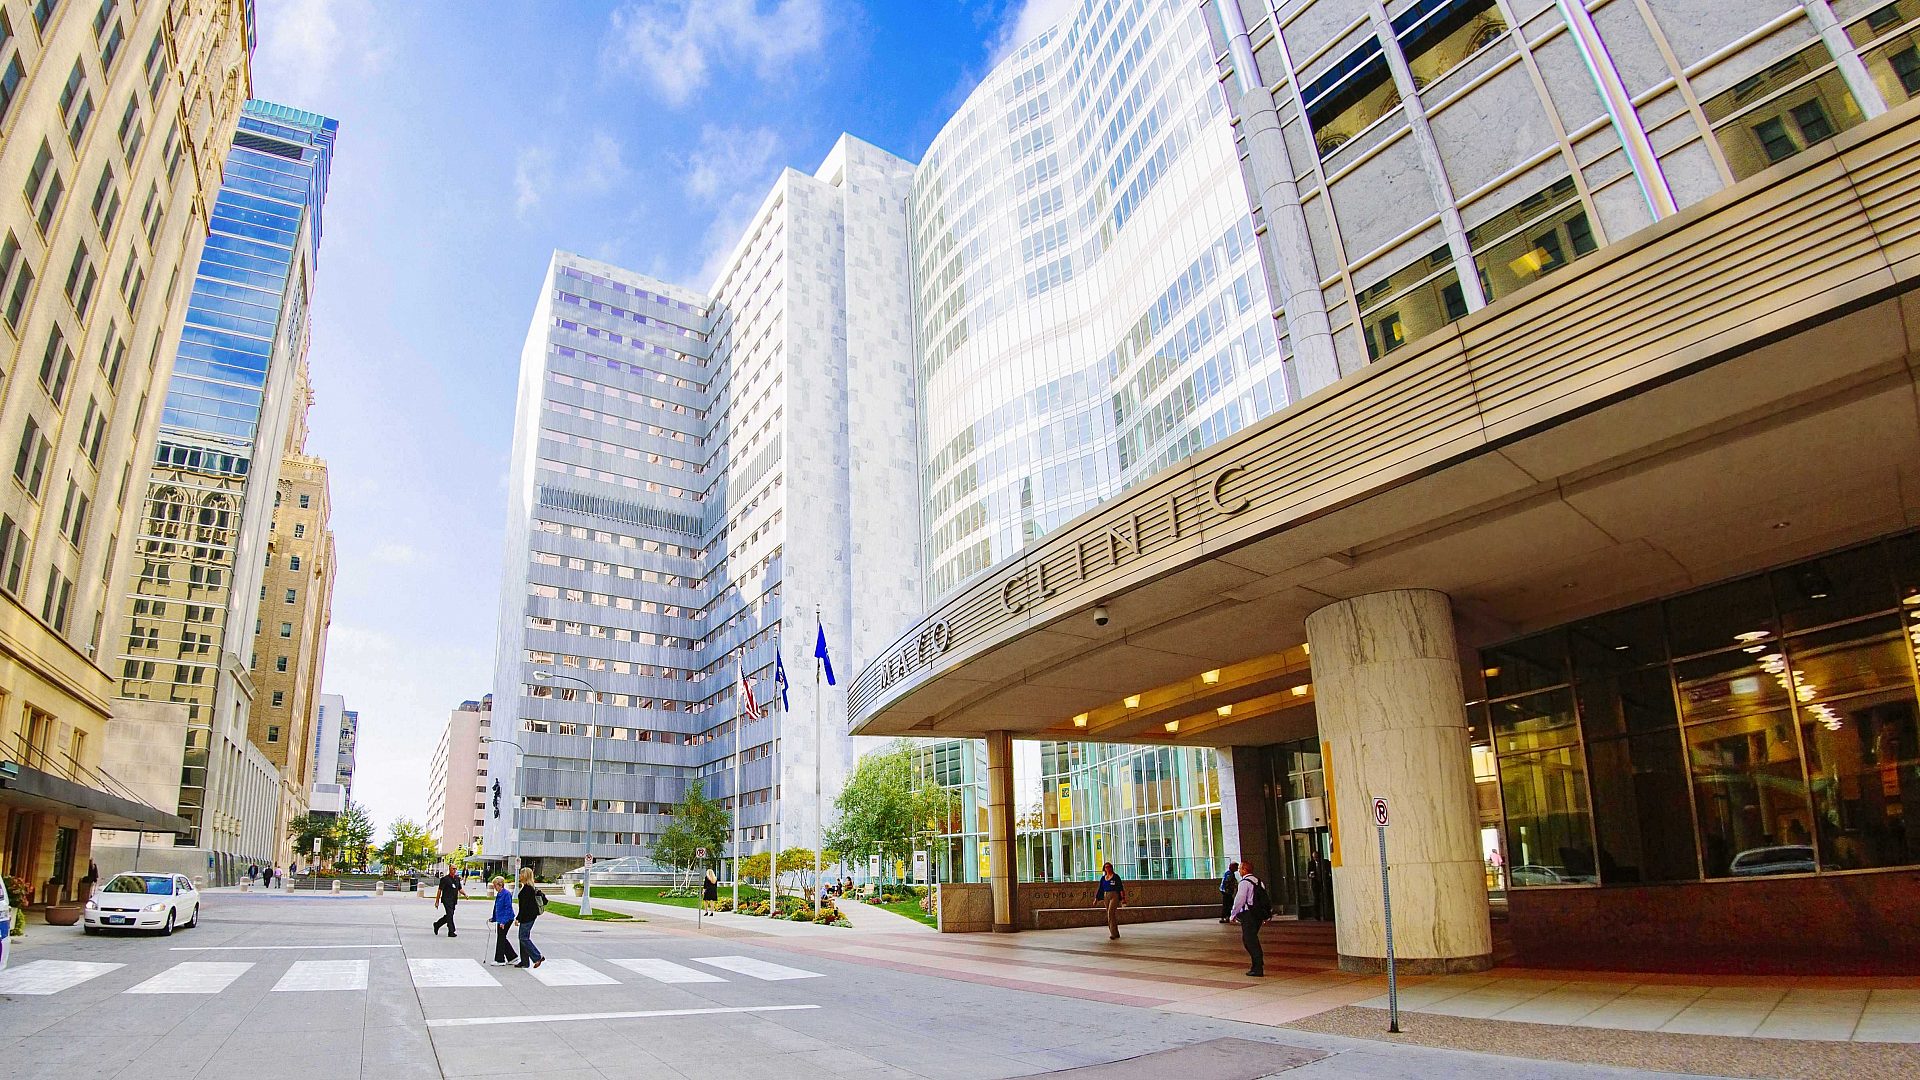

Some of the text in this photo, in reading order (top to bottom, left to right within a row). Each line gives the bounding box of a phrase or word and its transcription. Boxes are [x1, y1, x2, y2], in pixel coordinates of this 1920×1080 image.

[880, 463, 1250, 690] MAYO CLINIC
[1034, 890, 1075, 899] GONDA
